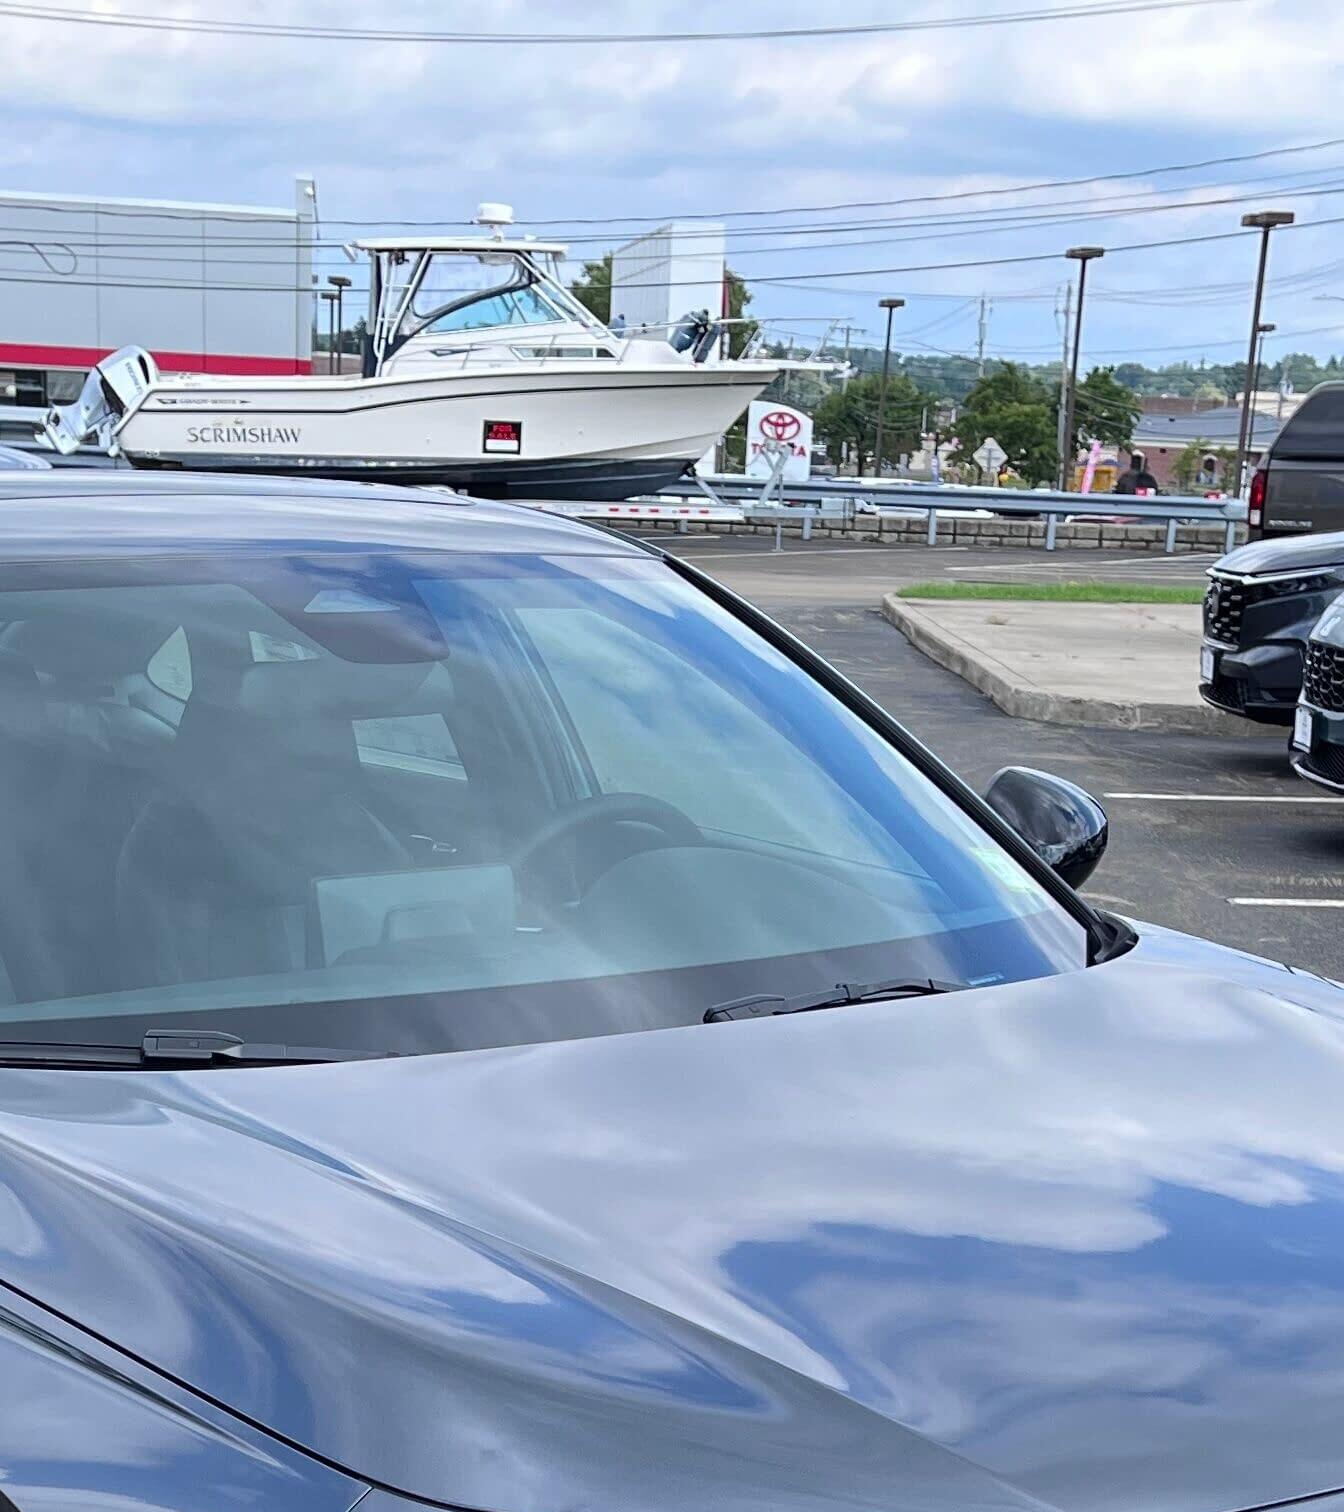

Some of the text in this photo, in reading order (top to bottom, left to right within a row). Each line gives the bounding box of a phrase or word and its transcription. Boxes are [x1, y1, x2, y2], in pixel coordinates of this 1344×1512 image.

[492, 424, 512, 432] FOR
[187, 427, 301, 443] SCRIMSHAW
[488, 432, 517, 440] SALE
[751, 442, 806, 457] TTA
